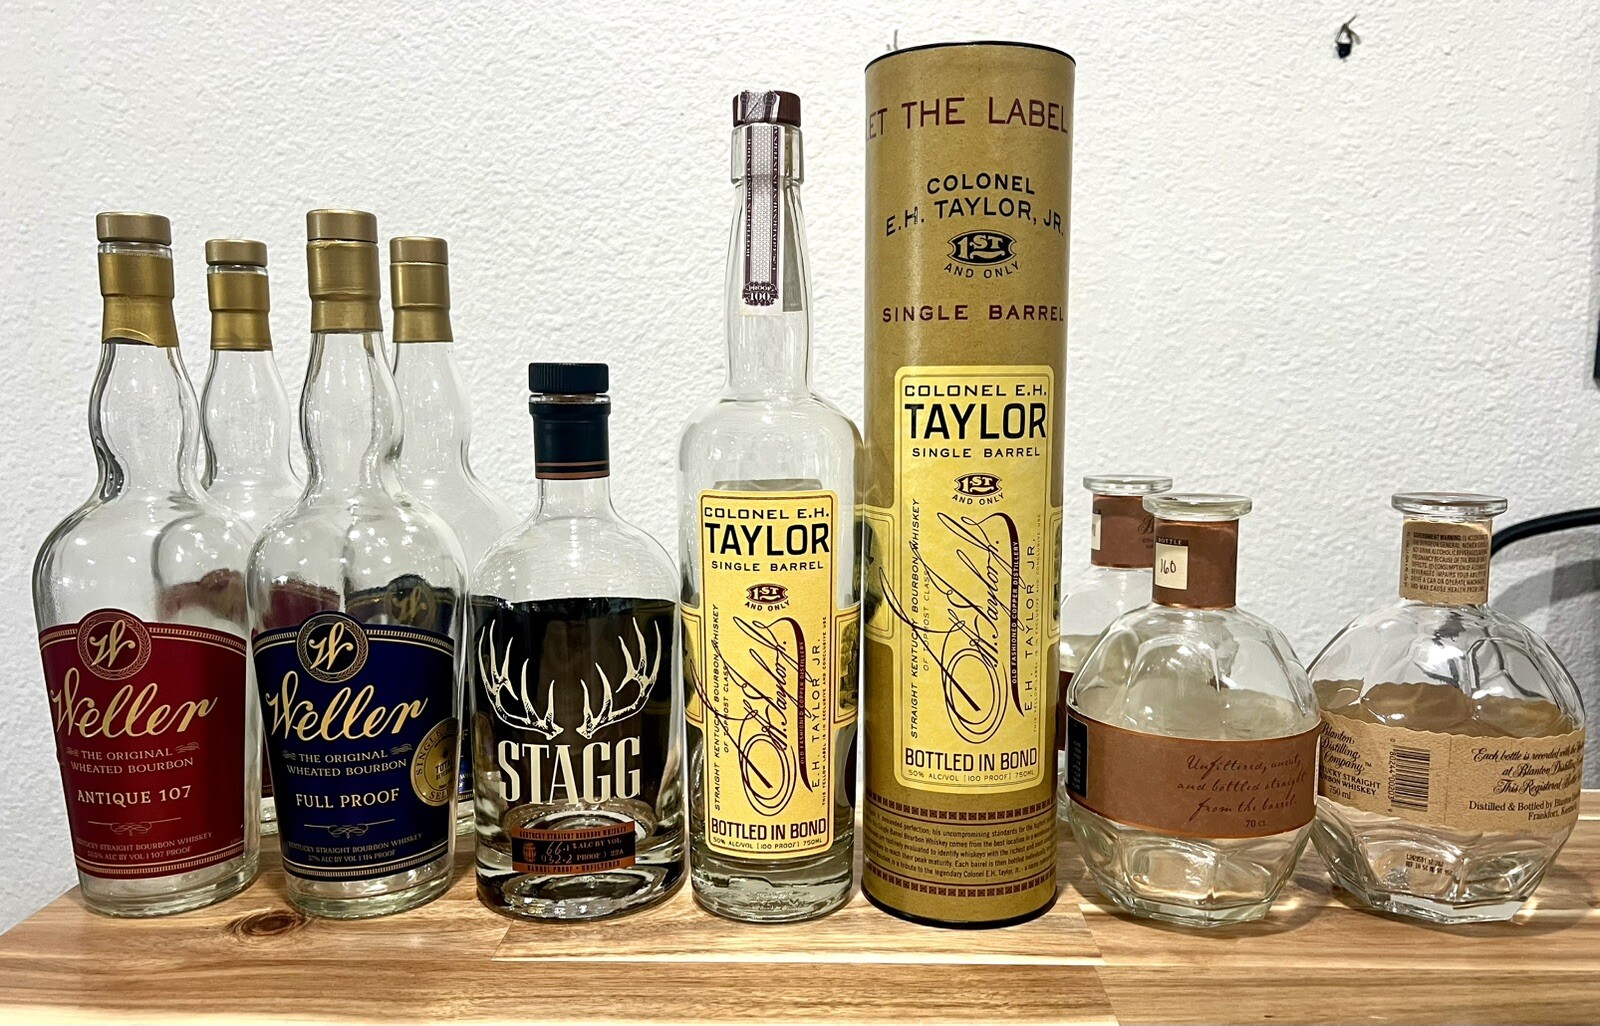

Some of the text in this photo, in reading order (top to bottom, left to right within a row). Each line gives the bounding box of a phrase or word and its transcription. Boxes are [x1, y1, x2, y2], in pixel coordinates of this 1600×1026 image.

[867, 96, 1068, 140] ET THE LABEL
[927, 172, 1035, 195] COLONEL
[886, 196, 1064, 237] E.H. TAYLOR, JR.
[957, 234, 1003, 260] 1ST
[944, 261, 1020, 279] AND ONLY
[882, 304, 1064, 323] SINGLE BARREL
[904, 384, 1047, 397] COLONEL E.H.
[904, 402, 1046, 440] TAYLOR
[912, 447, 1040, 458] SINGLE BARREL
[961, 476, 993, 493] 1ST
[952, 493, 1004, 505] AND ONLY
[704, 507, 829, 519] COLONEL E.H.
[911, 499, 920, 551] WHISKEY
[704, 522, 830, 556] TAYLOR
[711, 561, 823, 571] SINGLE BARREL
[753, 586, 779, 600] 1ST
[911, 556, 919, 613] BOURBON
[745, 600, 790, 611] AND ONLY
[1024, 539, 1035, 711] E.H. TAYLOR JR.
[923, 658, 929, 671] OF
[50, 667, 218, 739] Weller
[265, 670, 428, 741] Weller
[811, 639, 820, 788] E.H. TAYLOR JR.
[81, 748, 173, 761] THE ORIGINAL
[298, 749, 388, 763] THE ORIGINAL
[724, 741, 729, 753] OF
[1471, 748, 1499, 762] Each
[70, 757, 193, 774] WHEATED BOURBON
[418, 731, 446, 782] SINGLE
[905, 747, 1037, 771] BOTTLED IN BOND
[286, 759, 407, 777] WHEATED BOURBON
[497, 735, 641, 805] STAGG
[928, 773, 959, 782] ALC/VOL
[1211, 779, 1261, 791] bottled
[1342, 773, 1381, 789] STRAIGHT
[78, 784, 191, 810] ANTIQUE 107
[1341, 780, 1377, 796] WHISKEY
[296, 788, 400, 809] FULL PROOF
[1469, 800, 1506, 812] Distilled
[1507, 802, 1516, 811] &
[1518, 800, 1545, 811] Bottled
[1189, 797, 1233, 821] from
[1237, 797, 1256, 812] the
[711, 817, 826, 841] BOTTLED IN BOND
[1245, 820, 1256, 828] 70
[136, 840, 175, 852] BOURBON
[177, 831, 212, 846] WHISKEY
[315, 846, 350, 854] STRAIGHT
[352, 842, 390, 854] BOURBON
[391, 833, 422, 847] WHISKEY
[166, 846, 192, 857] PROOF
[576, 853, 601, 861] PROOF
